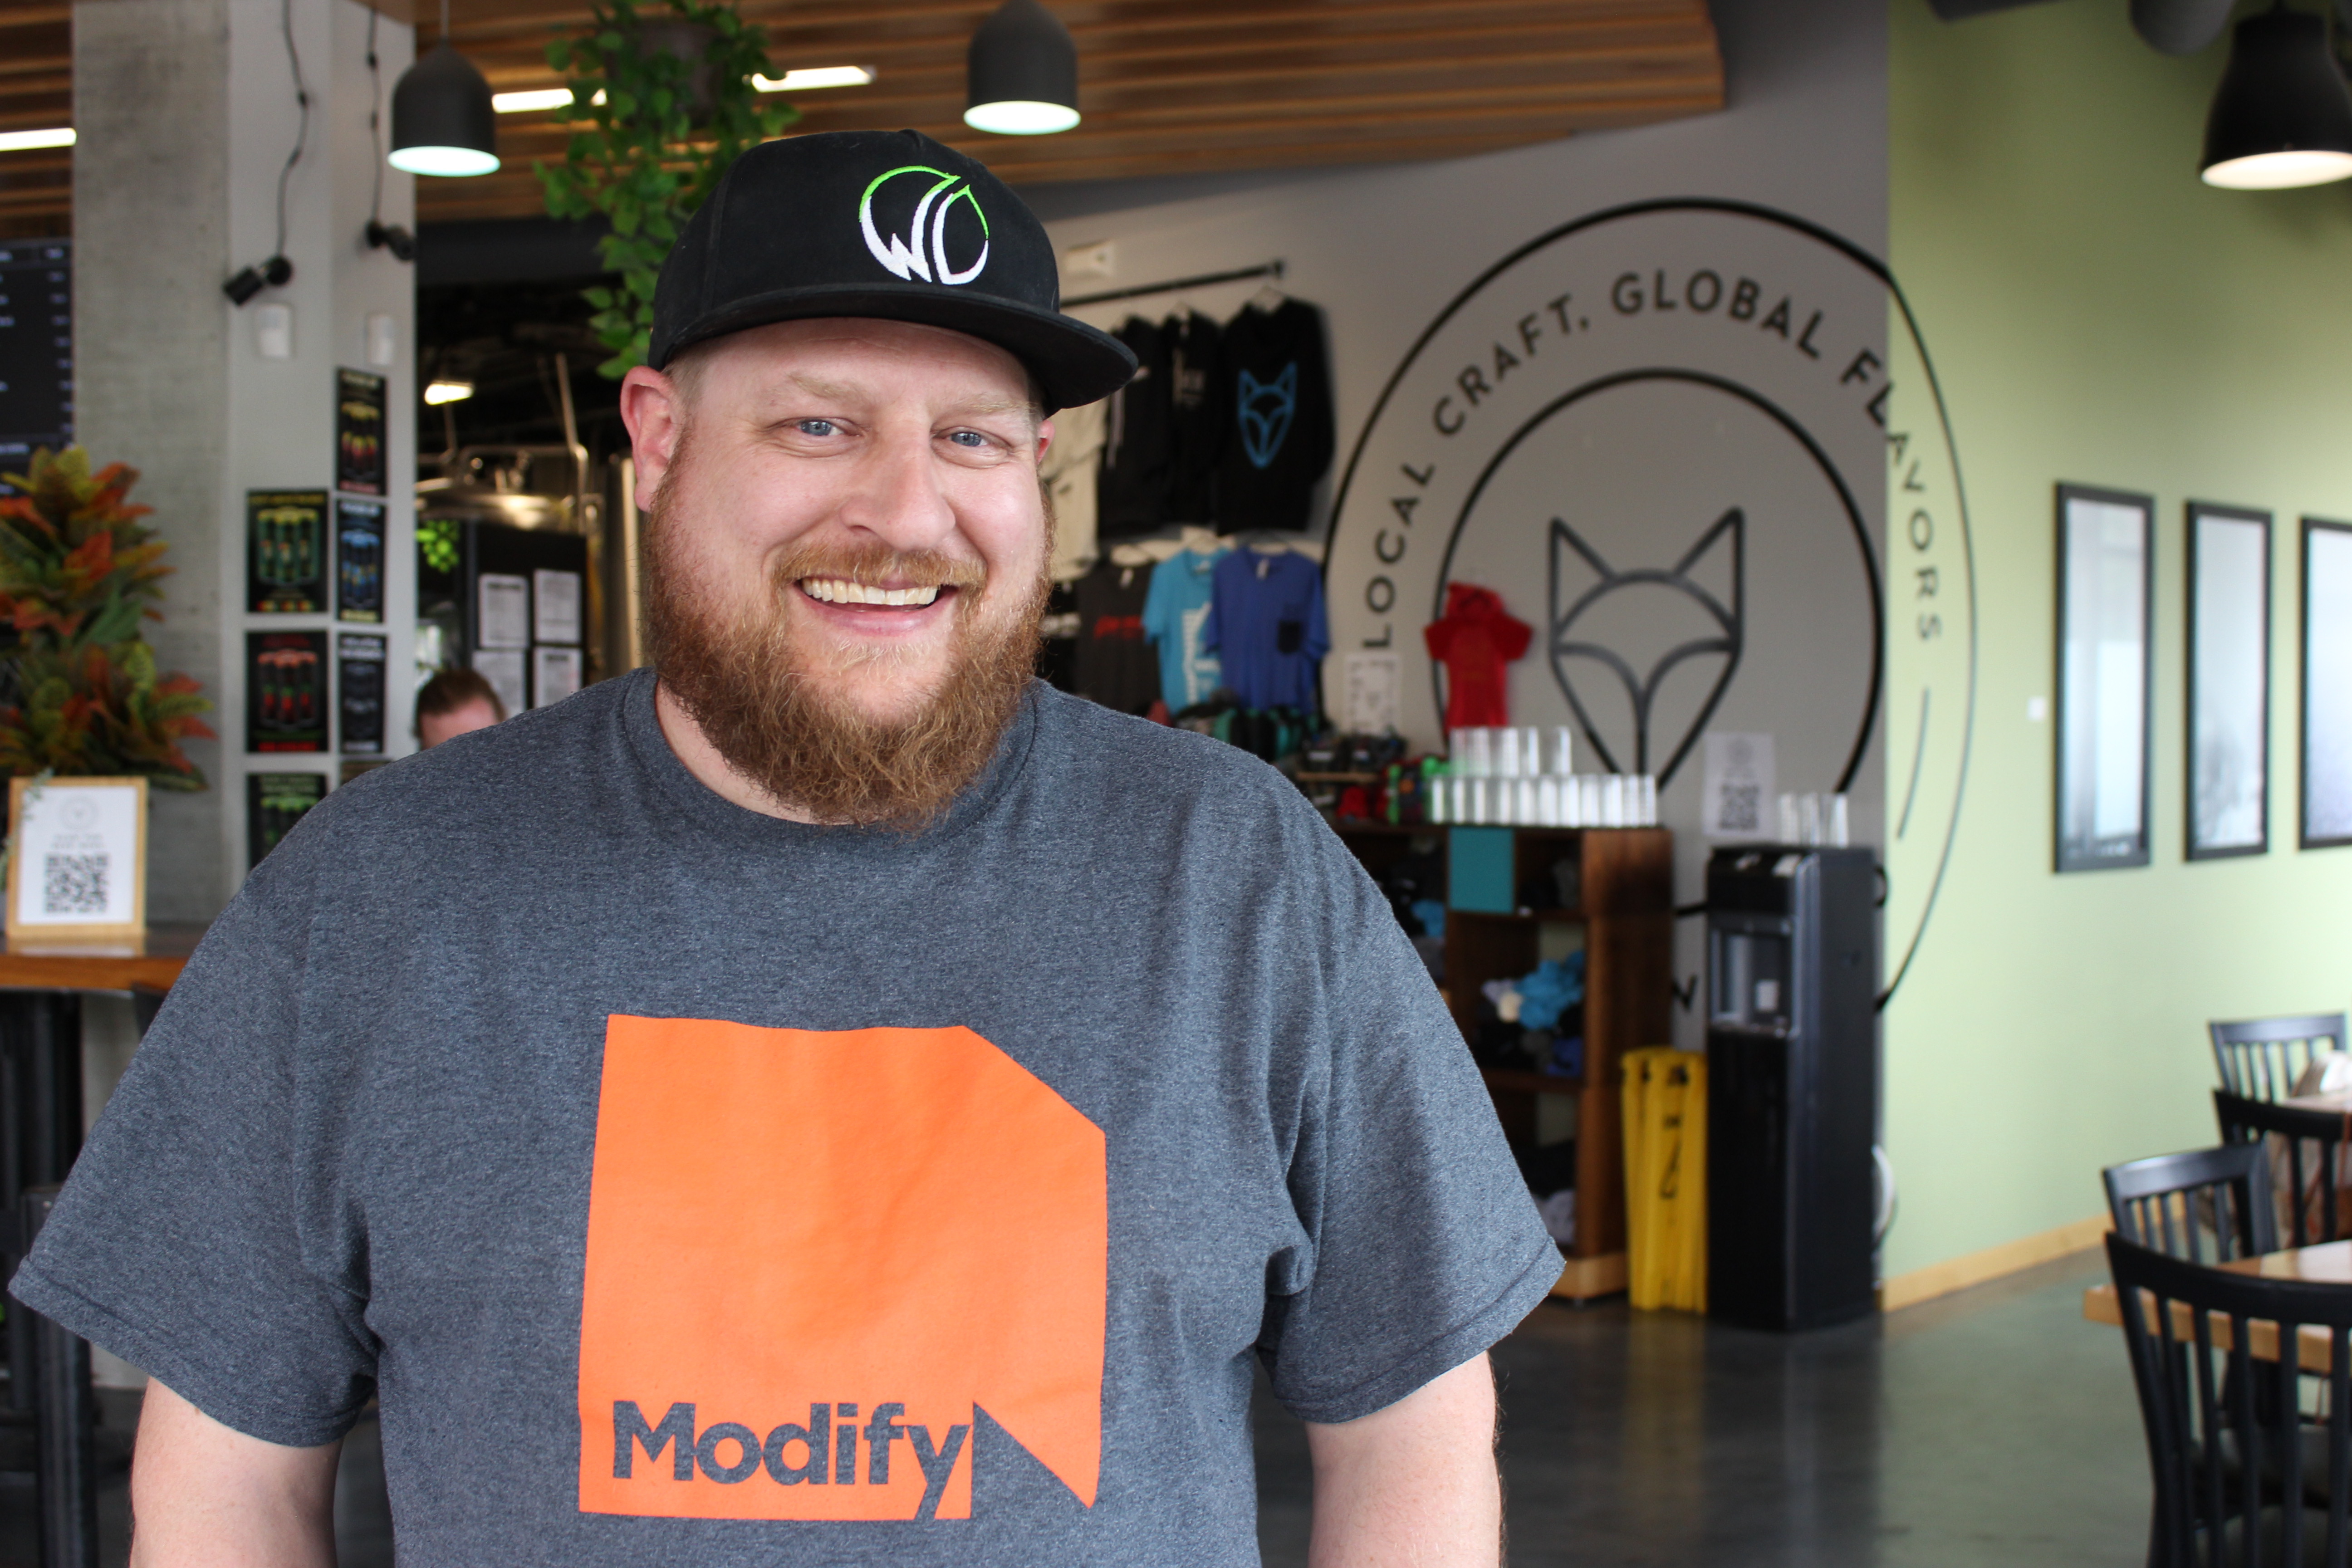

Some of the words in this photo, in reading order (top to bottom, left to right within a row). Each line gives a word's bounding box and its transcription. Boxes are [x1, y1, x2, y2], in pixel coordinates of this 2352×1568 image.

[1362, 463, 1435, 647] LOCAL
[1611, 269, 1823, 359] GLOBAL
[1839, 347, 1940, 640] FLAVORS
[613, 1401, 972, 1520] Modify
